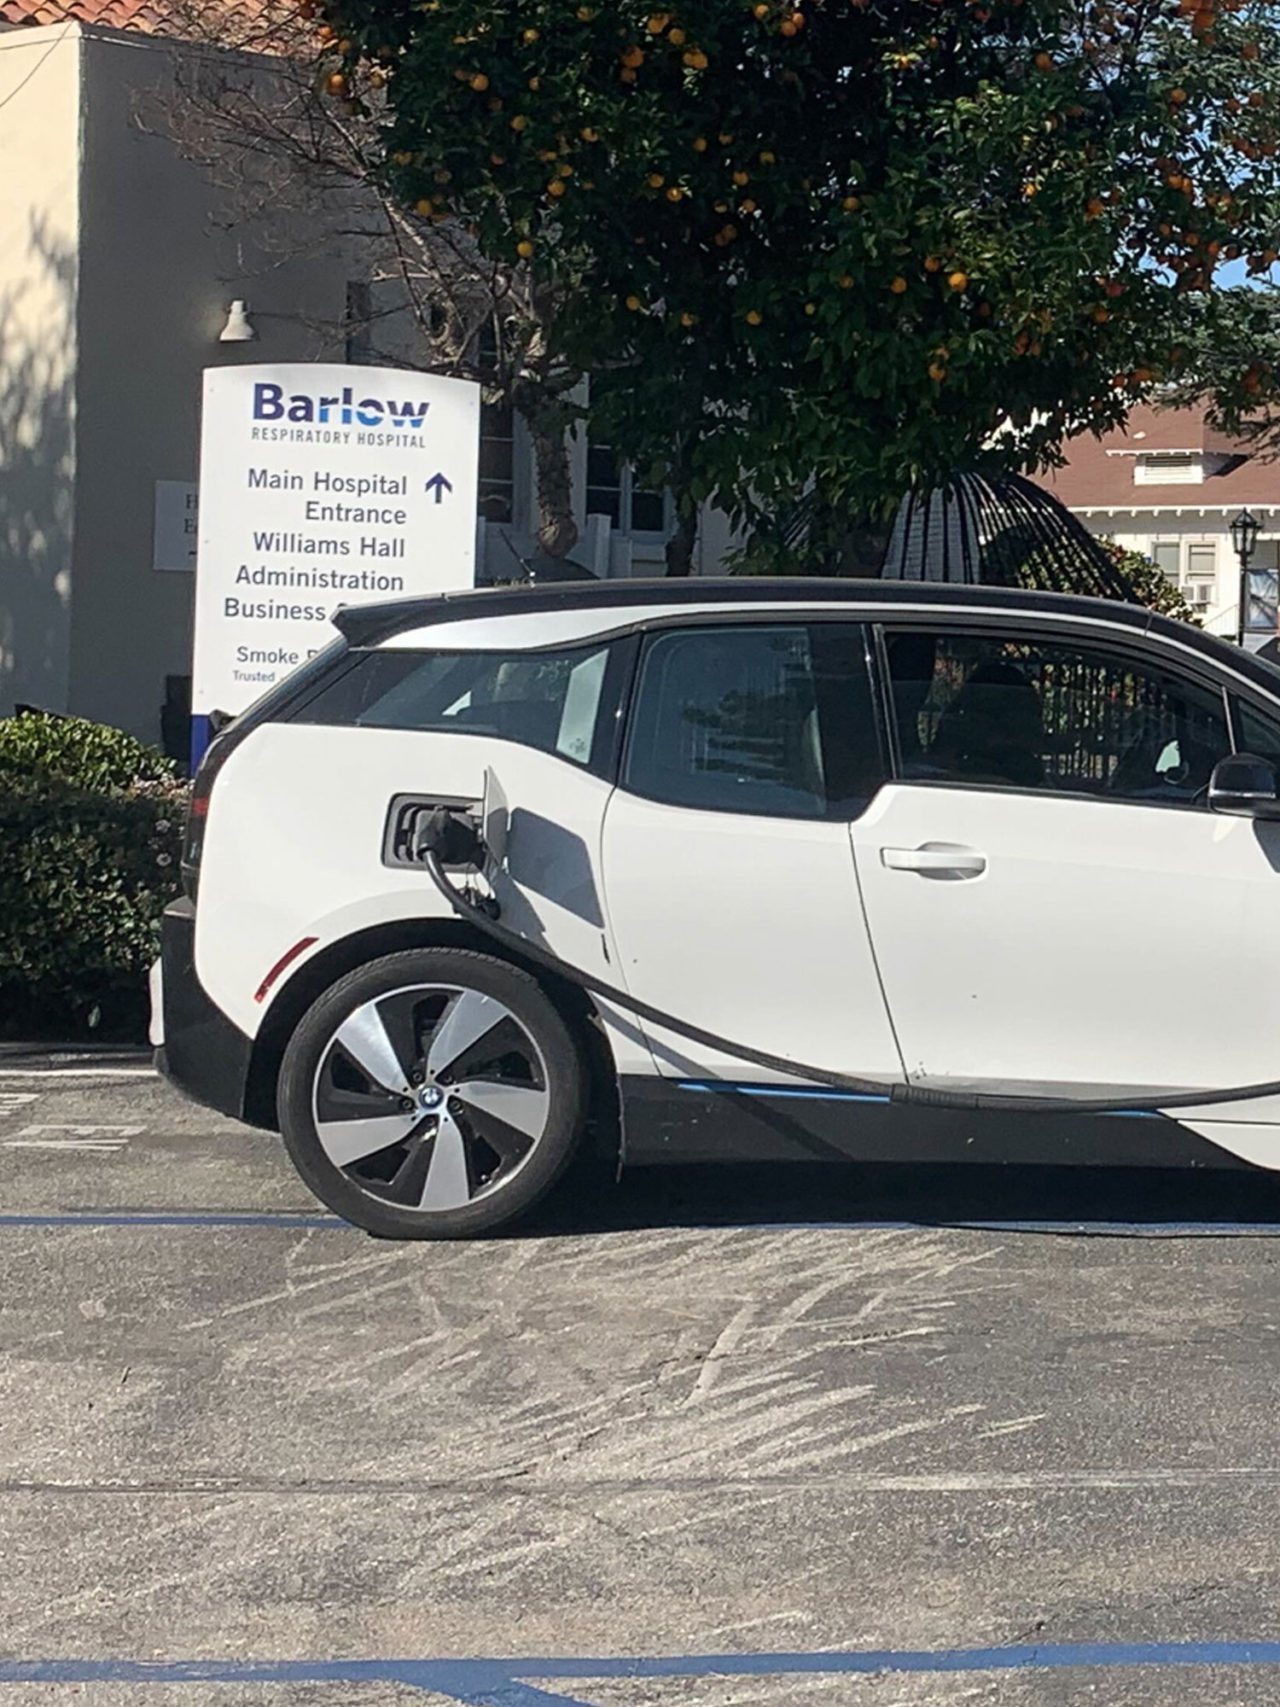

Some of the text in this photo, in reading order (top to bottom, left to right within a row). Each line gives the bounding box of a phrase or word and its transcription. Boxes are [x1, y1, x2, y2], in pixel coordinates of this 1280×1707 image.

[252, 383, 430, 428] Barlow
[251, 427, 426, 448] RESPIRATORY HOSPITAL
[248, 468, 407, 497] Main Hospital
[305, 501, 407, 525] Entrance
[253, 532, 405, 558] Williams Hall
[235, 565, 404, 591] Administration
[224, 597, 326, 621] Business
[236, 645, 299, 664] Smoke
[233, 669, 275, 682] Trusted
